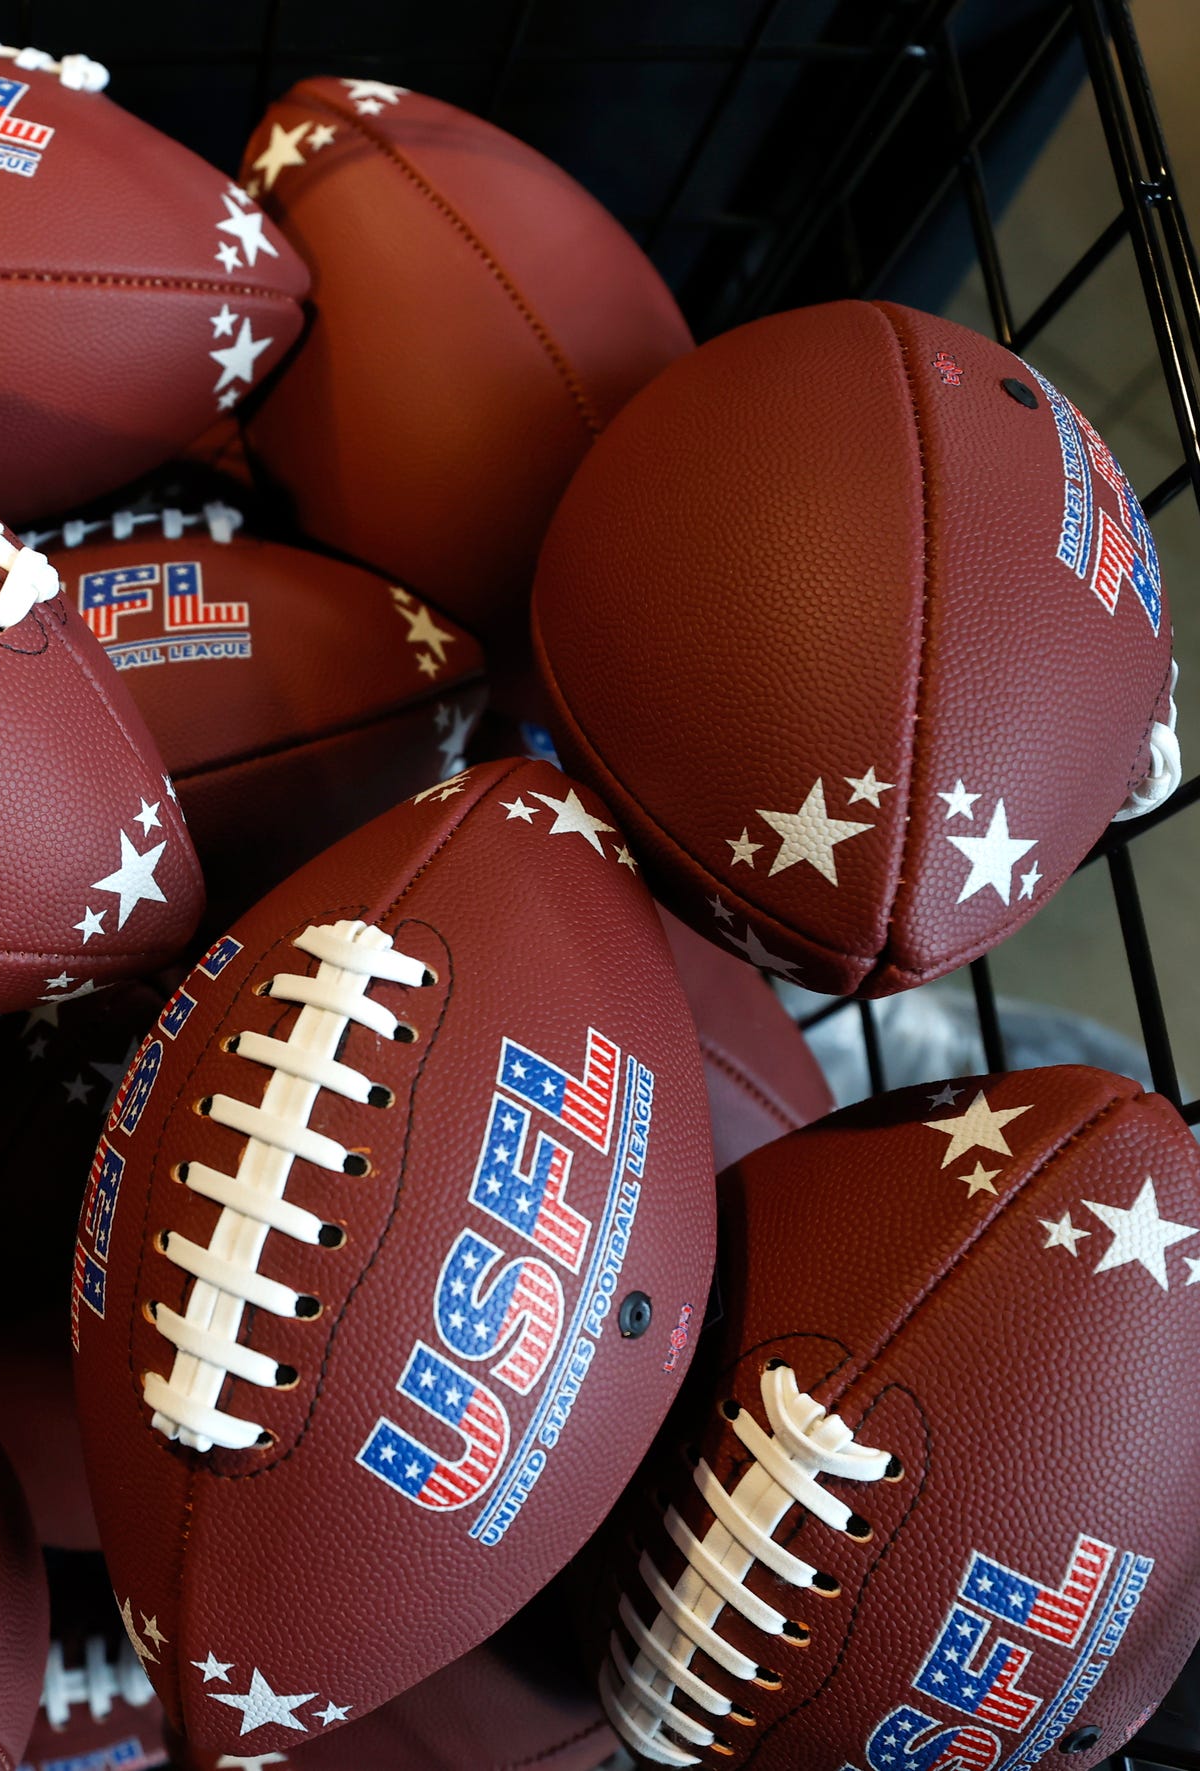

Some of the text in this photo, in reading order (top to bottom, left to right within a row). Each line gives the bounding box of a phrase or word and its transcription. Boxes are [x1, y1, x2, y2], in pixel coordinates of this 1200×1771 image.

[1056, 479, 1084, 569] LEAGUE
[110, 641, 252, 672] BALL LEAGUE
[355, 1026, 622, 1512] USFL
[479, 1063, 655, 1548] UNITED STATES FOOTBALL LEAGUE
[1024, 1659, 1109, 1765] FOOTBALL
[1099, 1555, 1156, 1657] LEAGUE
